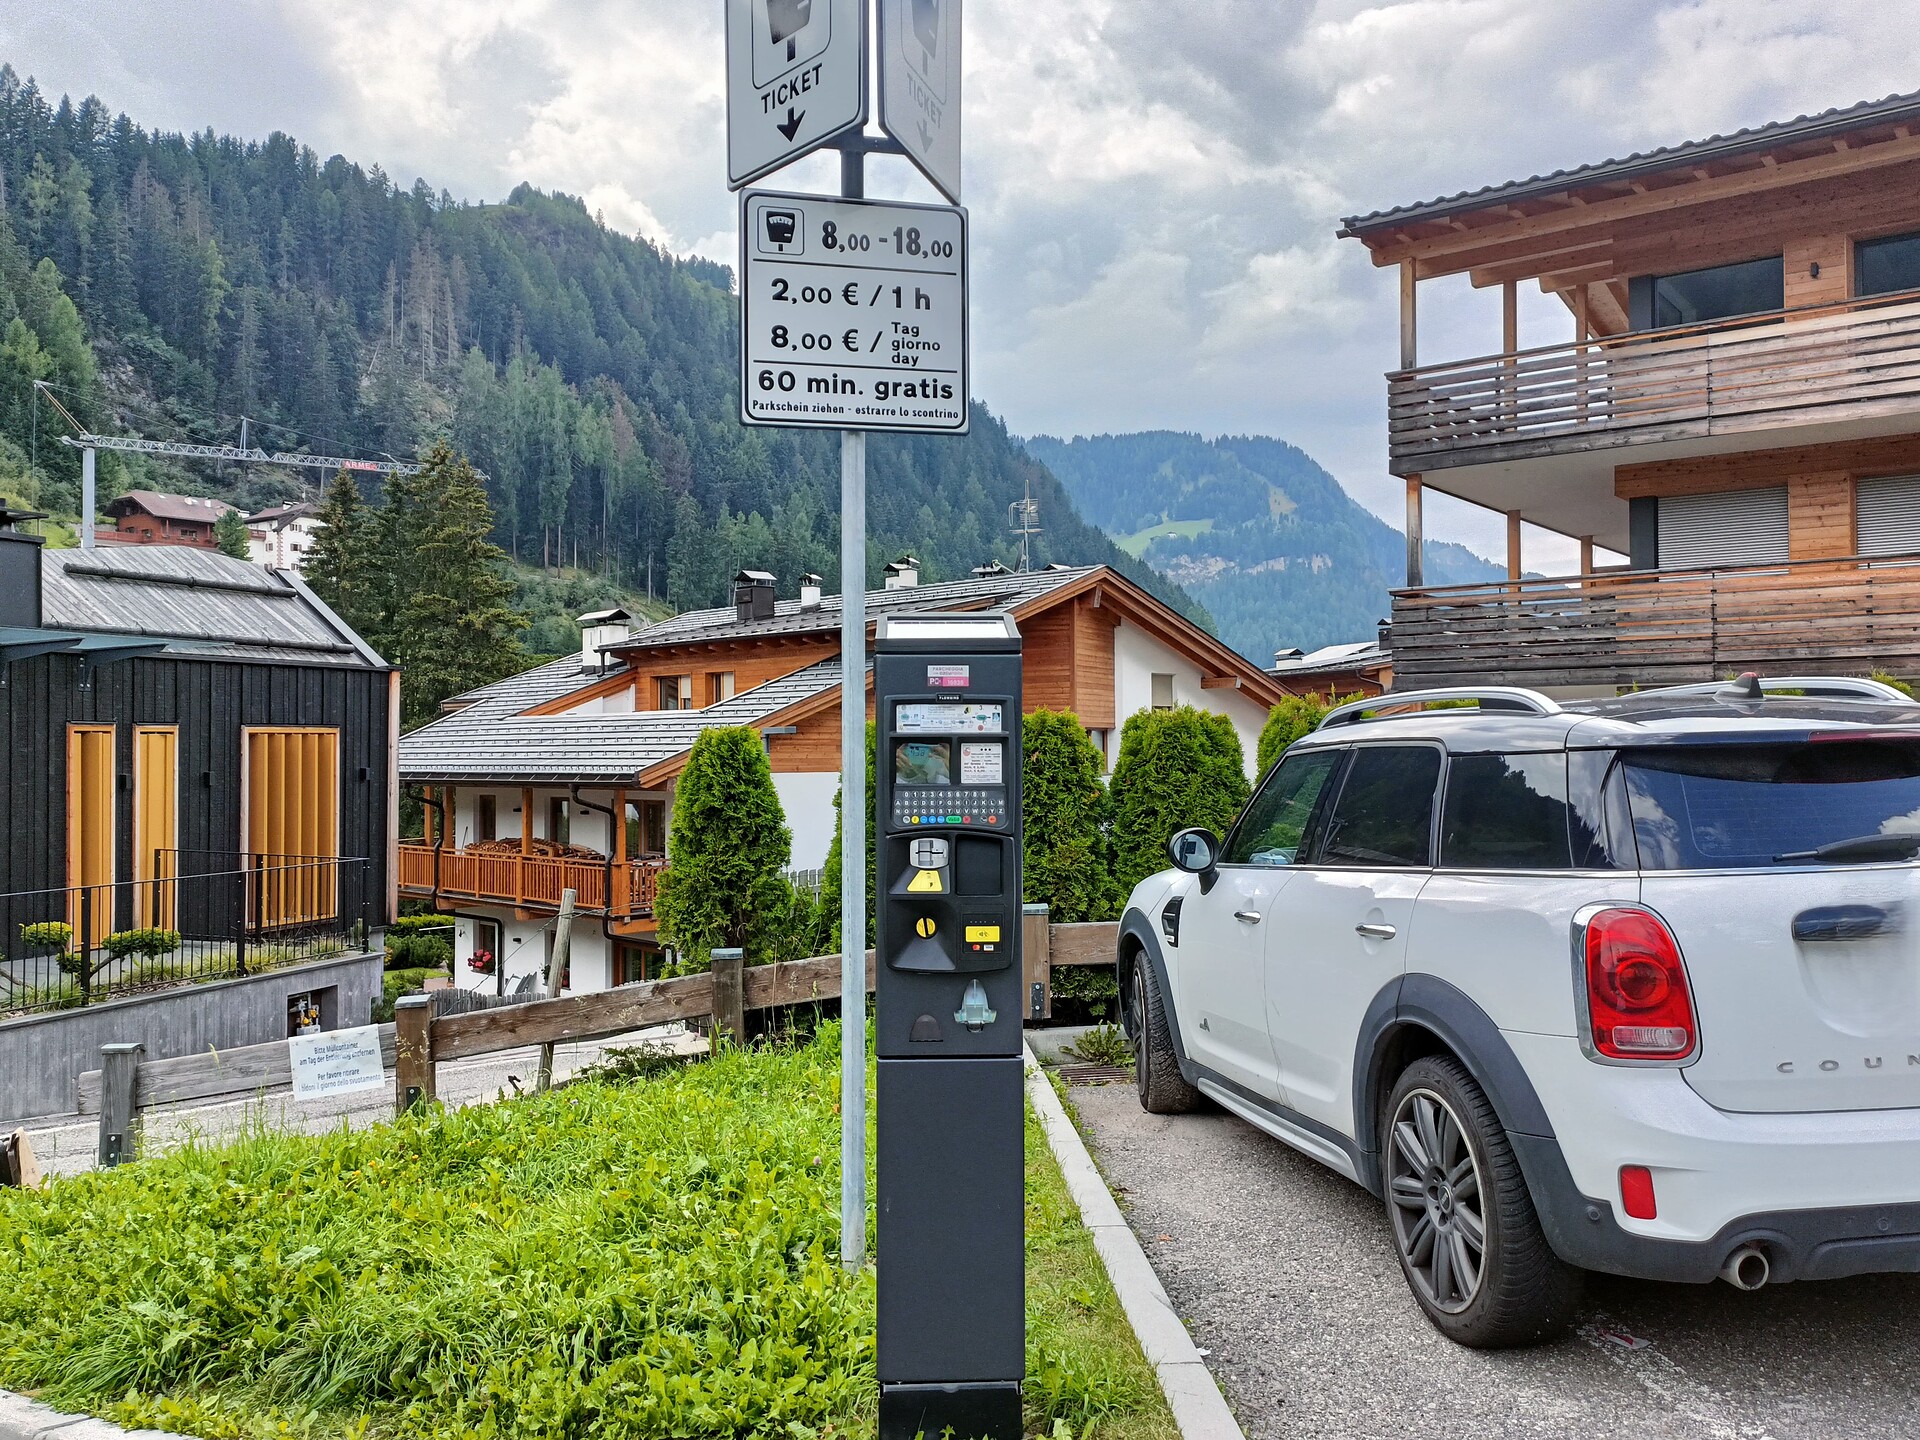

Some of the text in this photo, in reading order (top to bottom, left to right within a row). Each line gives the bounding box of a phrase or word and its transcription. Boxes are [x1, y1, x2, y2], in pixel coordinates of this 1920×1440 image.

[761, 62, 822, 114] TICKET
[907, 72, 943, 129] TICKET
[821, 220, 870, 253] 8,00
[892, 226, 953, 259] 18,00
[771, 278, 931, 310] 2,00 € / 1 h
[770, 324, 883, 353] 8,00 € /
[891, 321, 920, 338] Tag
[891, 337, 941, 351] giorno
[891, 352, 920, 367] day
[758, 369, 954, 400] 60 min. gratis
[752, 400, 809, 412] Parkschein
[812, 402, 844, 414] ziehen
[855, 406, 896, 416] estrarre
[900, 406, 909, 416] lo
[912, 407, 959, 419] scontrino
